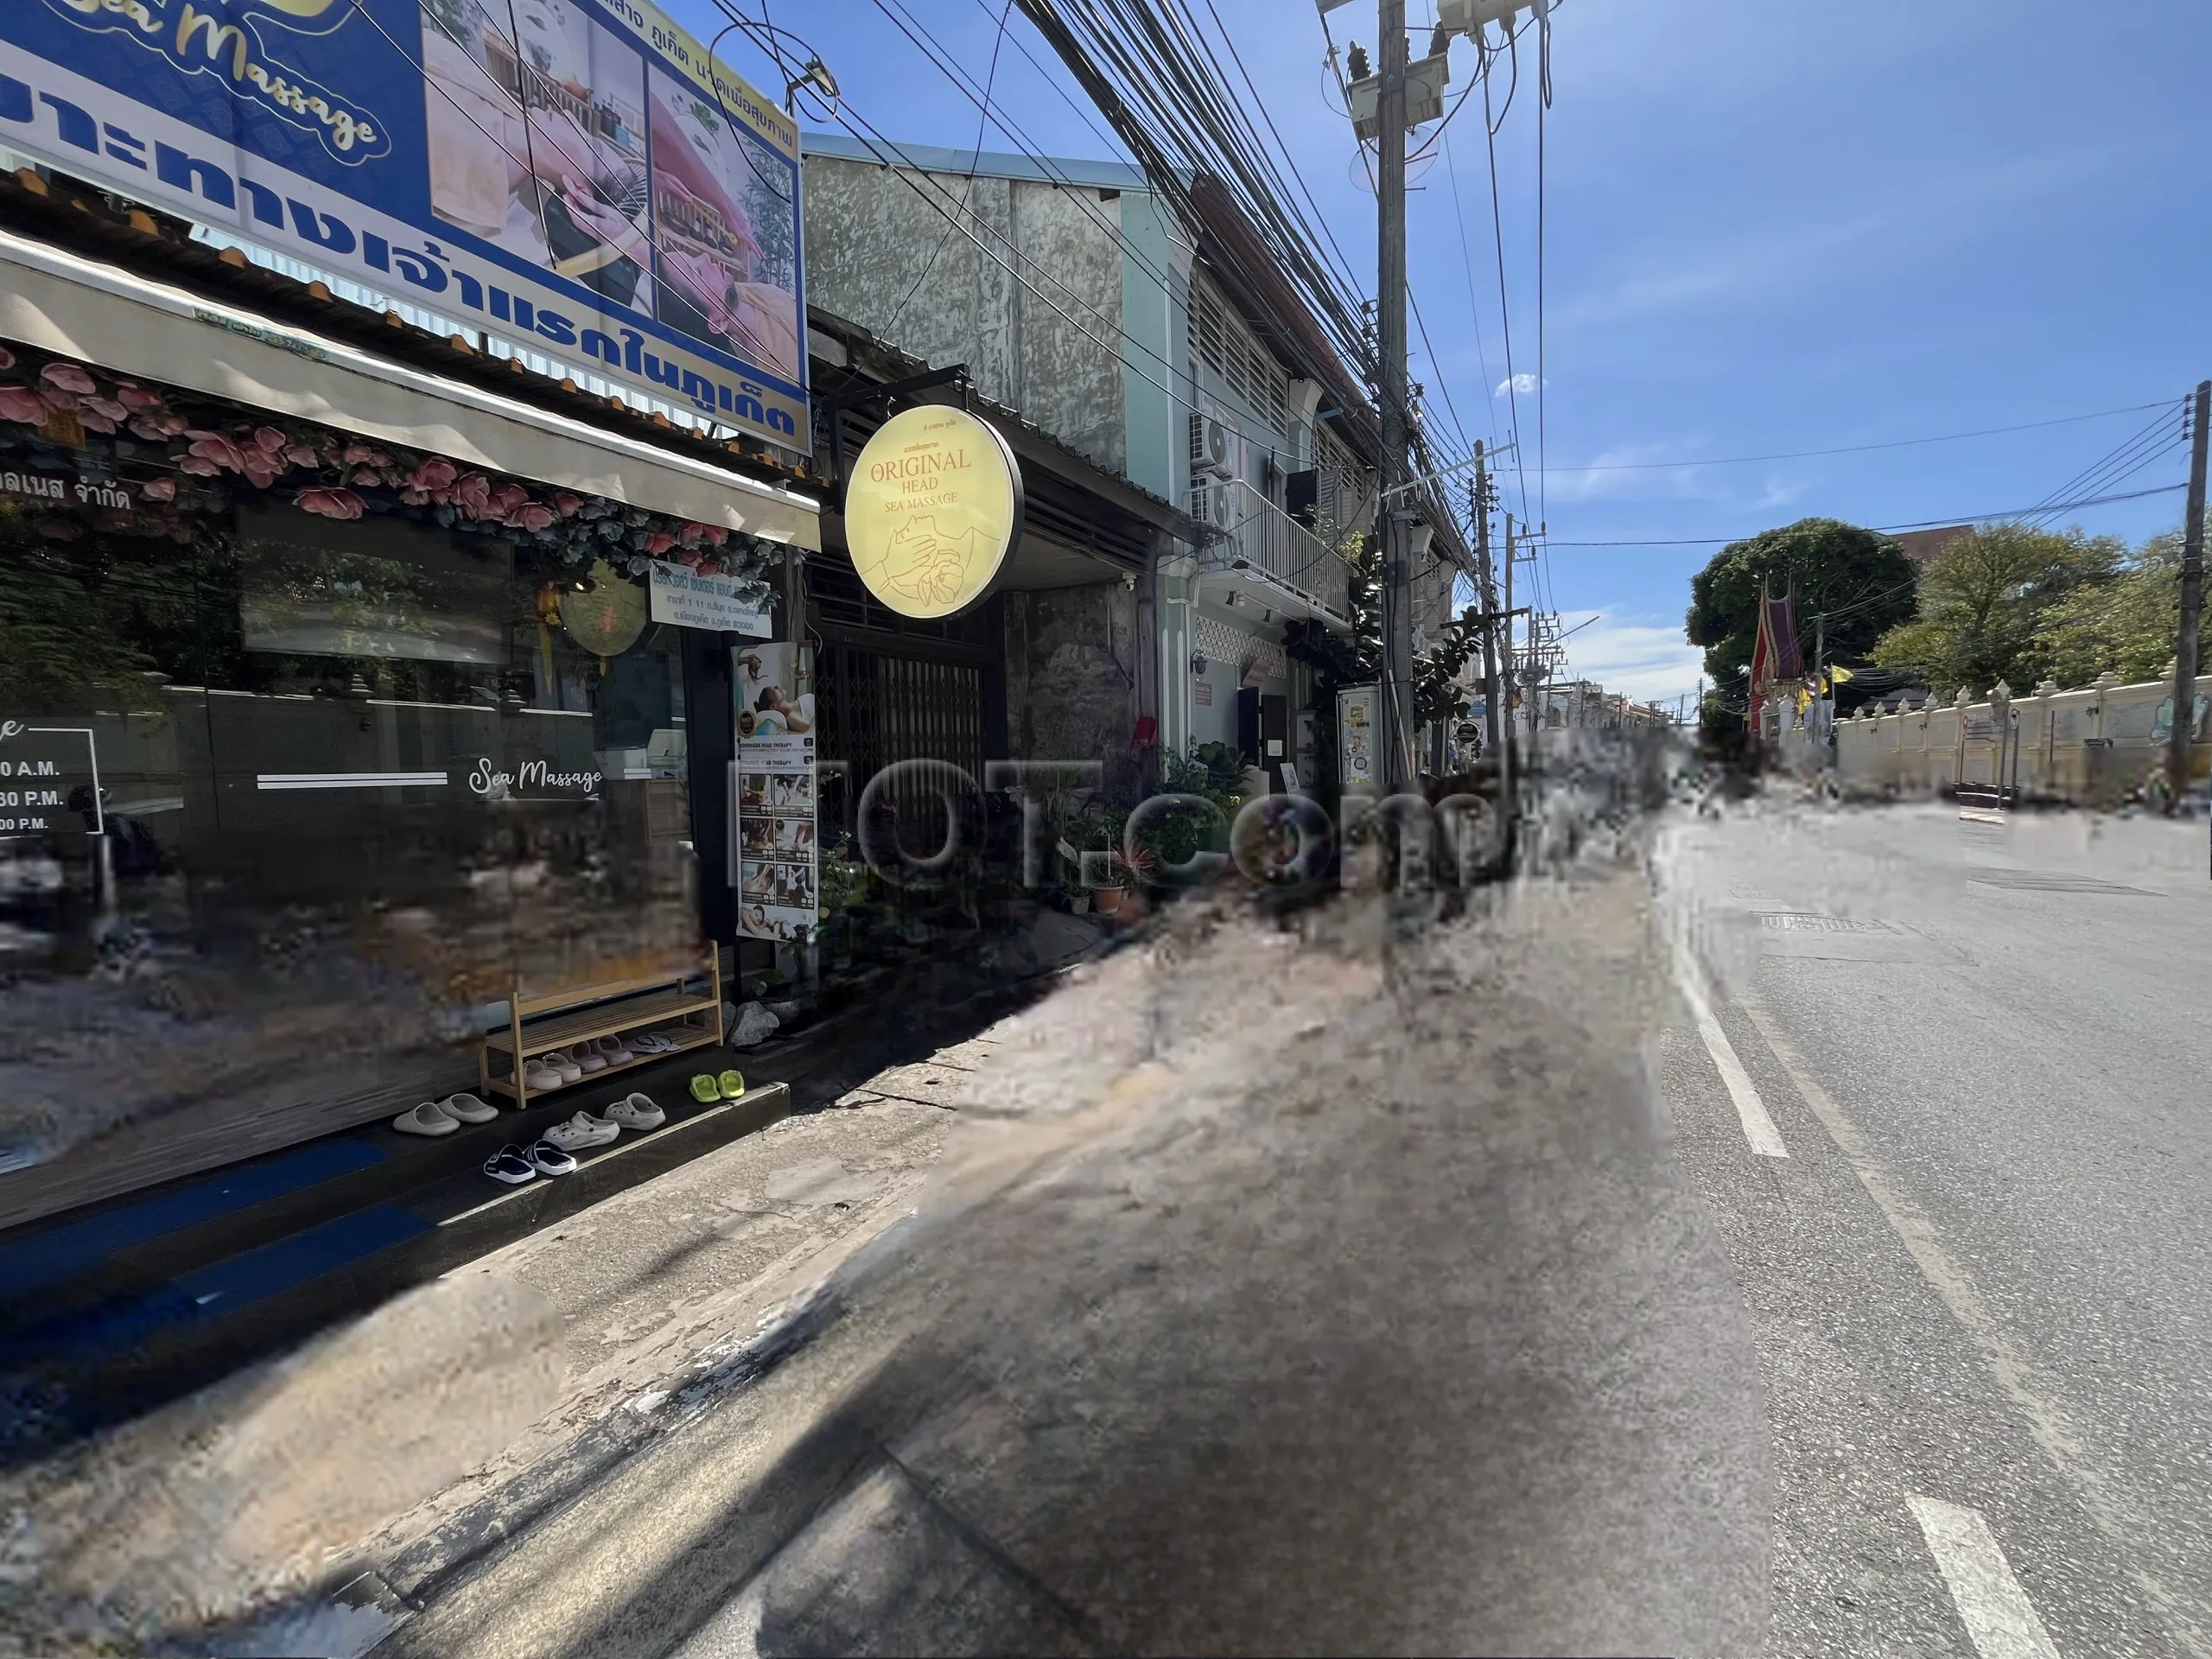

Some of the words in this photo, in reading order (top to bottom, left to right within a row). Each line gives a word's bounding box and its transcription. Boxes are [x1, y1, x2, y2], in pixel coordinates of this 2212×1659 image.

[652, 24, 690, 67] ภูเก็ต
[176, 3, 378, 151] Massage
[870, 448, 972, 483] ORIGINAL
[0, 472, 65, 499] ลเนส
[74, 475, 130, 510] จำกัด
[902, 476, 938, 495] HEAD
[885, 500, 904, 513] SEA
[907, 492, 958, 511] MASSAGE
[732, 620, 754, 631] 83000
[17, 760, 60, 776] A.M.
[468, 757, 516, 794] Sea
[518, 760, 602, 792] Massage
[24, 790, 64, 806] P.M.
[19, 817, 49, 830] P.M.
